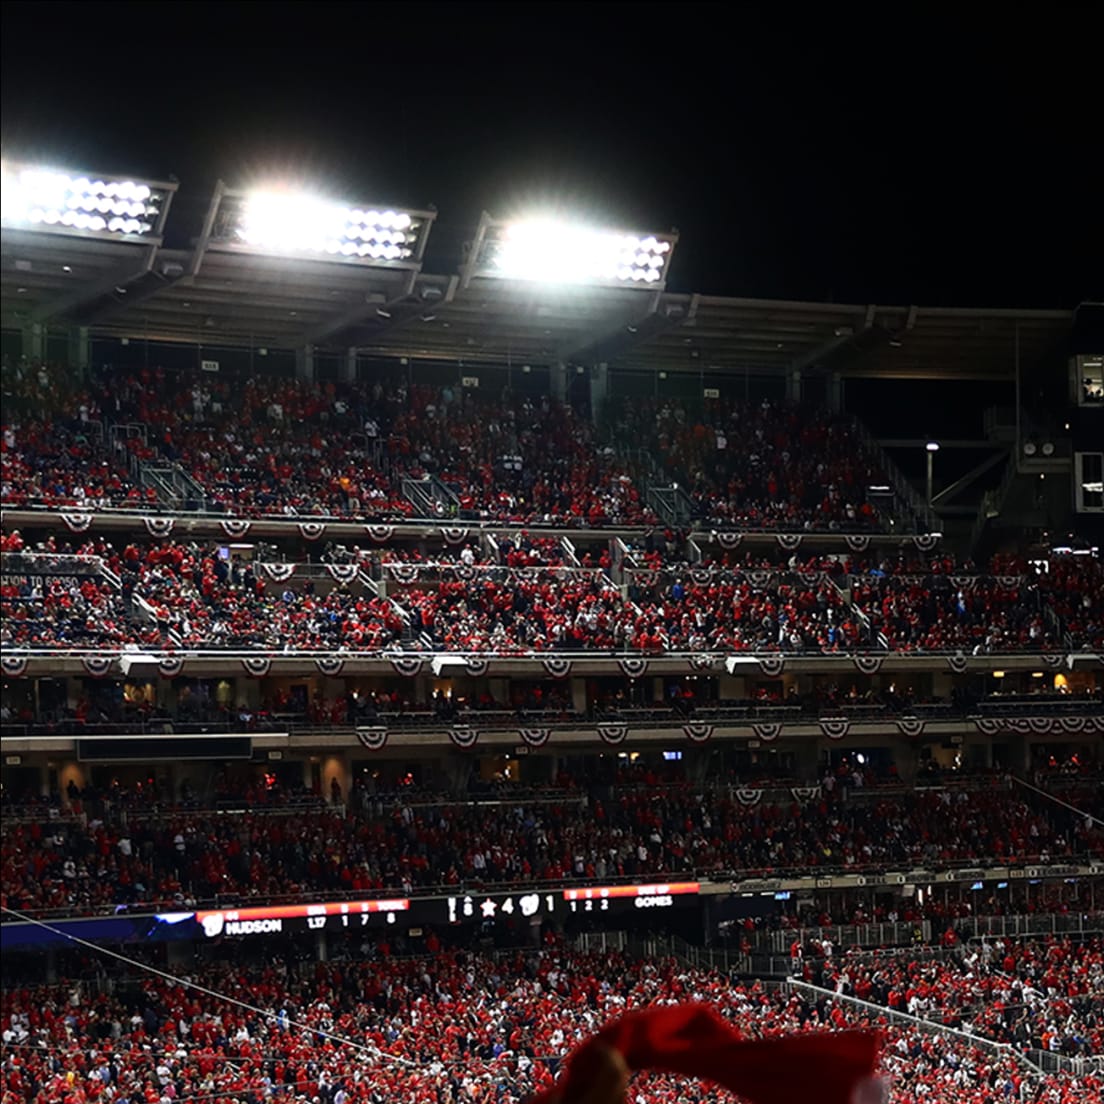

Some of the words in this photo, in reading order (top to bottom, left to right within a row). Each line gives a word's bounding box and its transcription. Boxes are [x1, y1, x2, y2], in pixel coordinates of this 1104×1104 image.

[502, 898, 513, 914] 4
[546, 895, 553, 911] 1
[571, 902, 576, 911] 1
[586, 901, 592, 910] 2
[600, 899, 608, 909] 2
[635, 896, 672, 907] GOMES
[342, 915, 348, 926] 1
[362, 914, 368, 925] 7
[388, 912, 395, 923] 8
[226, 920, 281, 934] HUDSON
